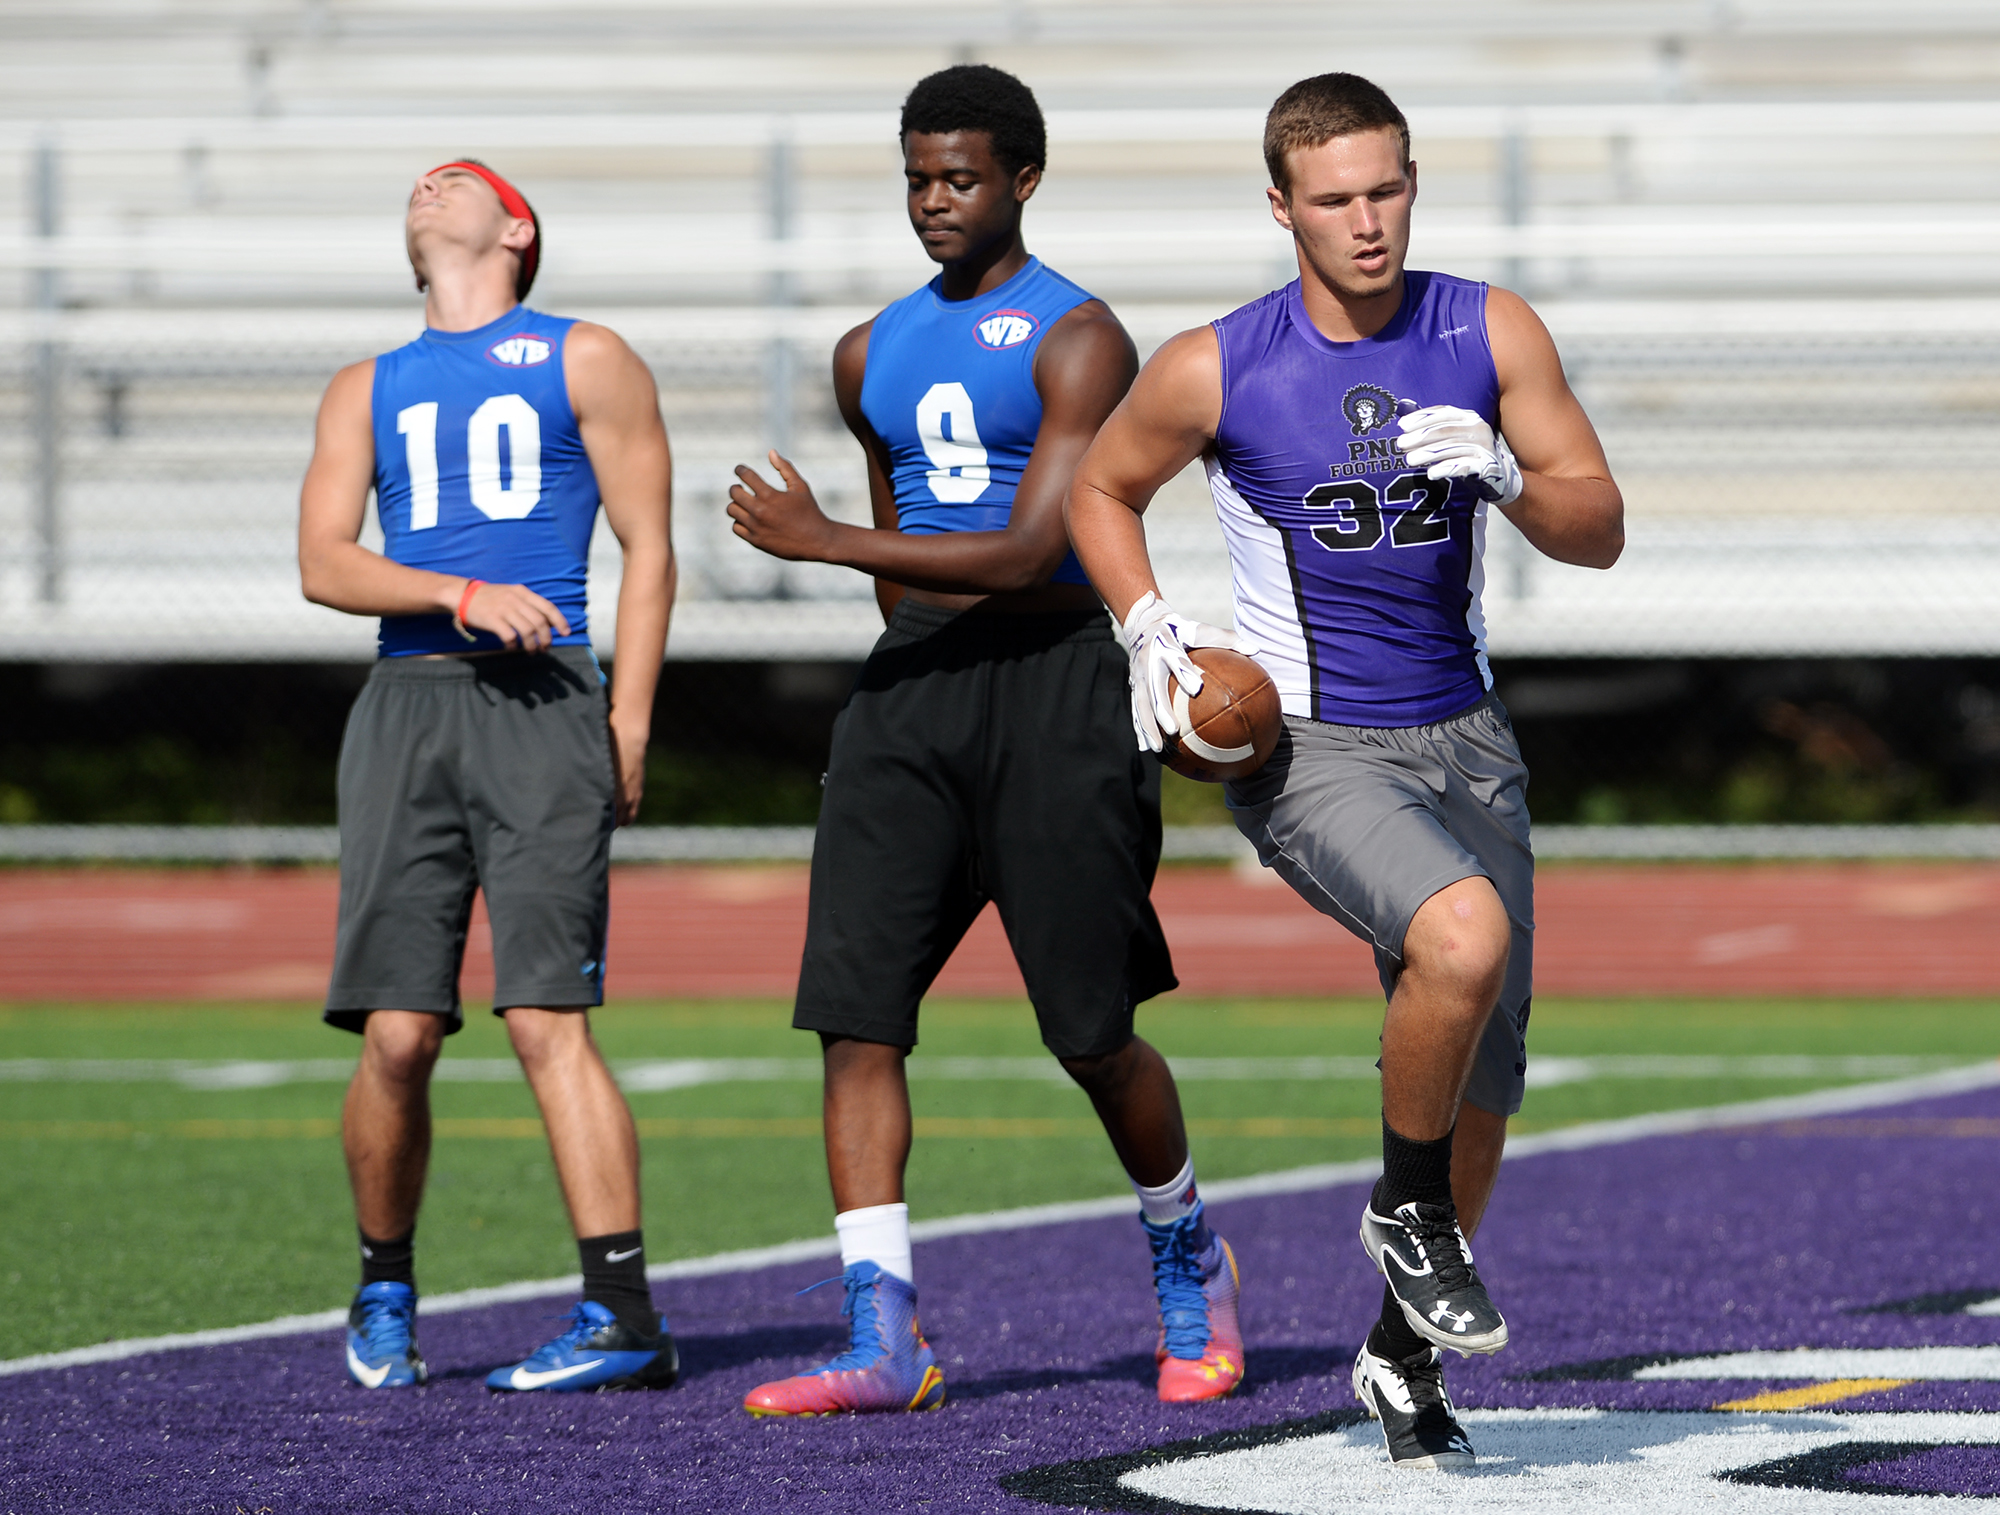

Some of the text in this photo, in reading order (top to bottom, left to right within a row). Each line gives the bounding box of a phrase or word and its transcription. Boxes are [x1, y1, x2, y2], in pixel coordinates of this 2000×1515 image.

[490, 338, 550, 365] WB
[979, 316, 1032, 346] WB
[396, 393, 542, 532] 10
[916, 382, 992, 504] 9
[1329, 457, 1432, 479] FOOTBA
[1302, 472, 1453, 552] 32
